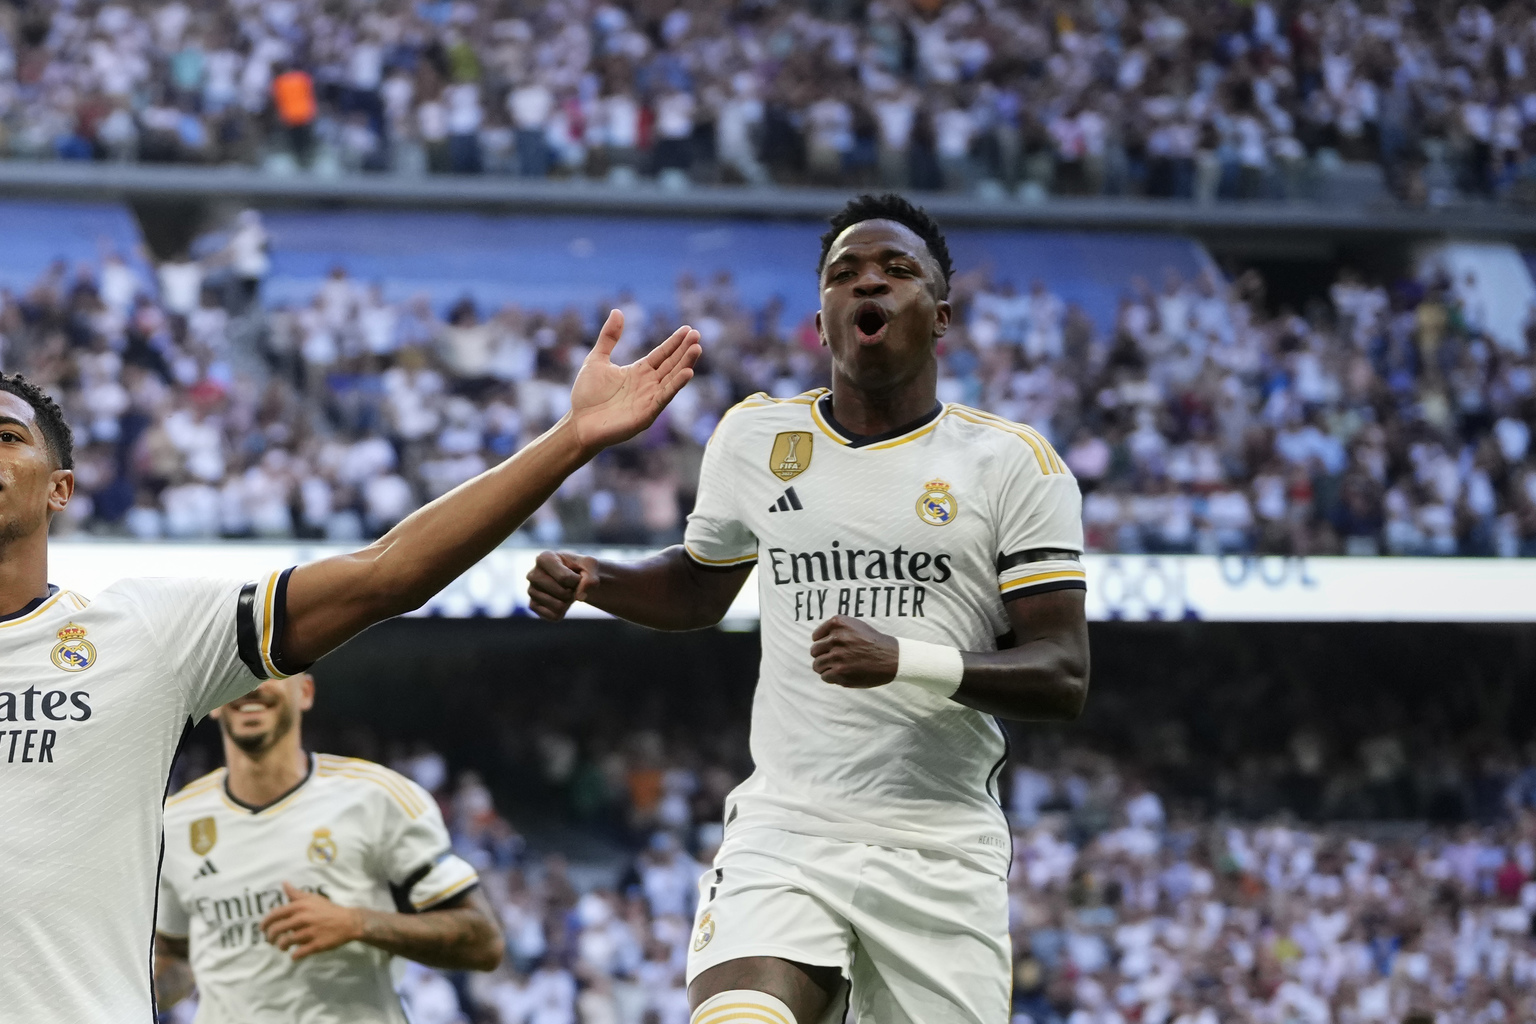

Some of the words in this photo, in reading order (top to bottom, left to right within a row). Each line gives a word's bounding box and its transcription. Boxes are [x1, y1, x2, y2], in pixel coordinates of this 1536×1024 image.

[768, 540, 953, 585] Emirates
[795, 589, 827, 621] FLY
[838, 585, 928, 620] BETTER
